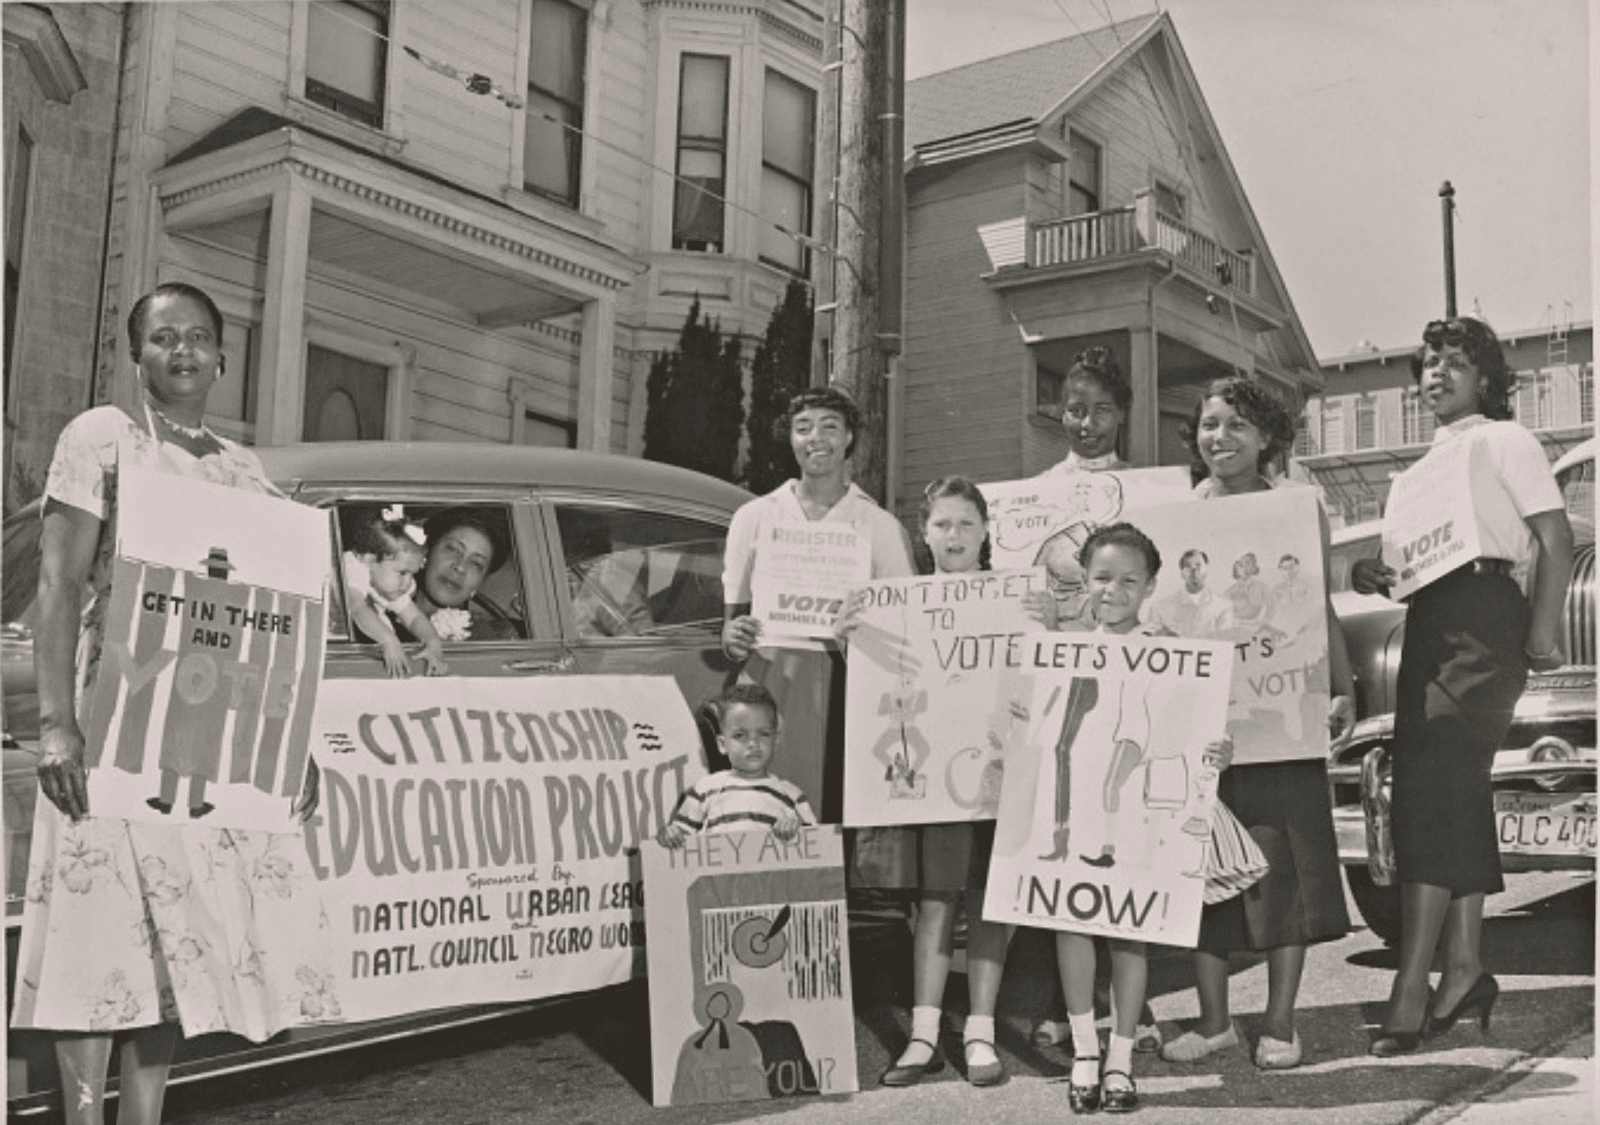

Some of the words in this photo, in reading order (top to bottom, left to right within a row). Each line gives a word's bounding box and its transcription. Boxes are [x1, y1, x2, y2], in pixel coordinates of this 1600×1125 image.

[771, 527, 858, 549] REGISTER
[1014, 515, 1050, 529] VOTE
[1403, 521, 1453, 564] VOTE
[141, 591, 185, 617] GET
[190, 601, 216, 622] IN
[225, 605, 292, 635] THERE
[778, 593, 845, 615] VOTE
[922, 608, 955, 631] TO
[191, 628, 232, 650] AND
[932, 632, 1026, 671] VOTE
[1033, 642, 1108, 670] LET'S
[1122, 645, 1213, 677] VOTE
[105, 641, 297, 720] VOTE
[356, 706, 630, 766] CITIZENSHIP
[1500, 813, 1551, 845] CLC
[352, 893, 491, 935] NATIONAL
[505, 886, 591, 919] URBAN
[351, 945, 426, 979] NATL.
[428, 933, 519, 968] COUNCIL
[529, 926, 593, 959] NEGRO
[756, 1056, 837, 1096] YOU?
